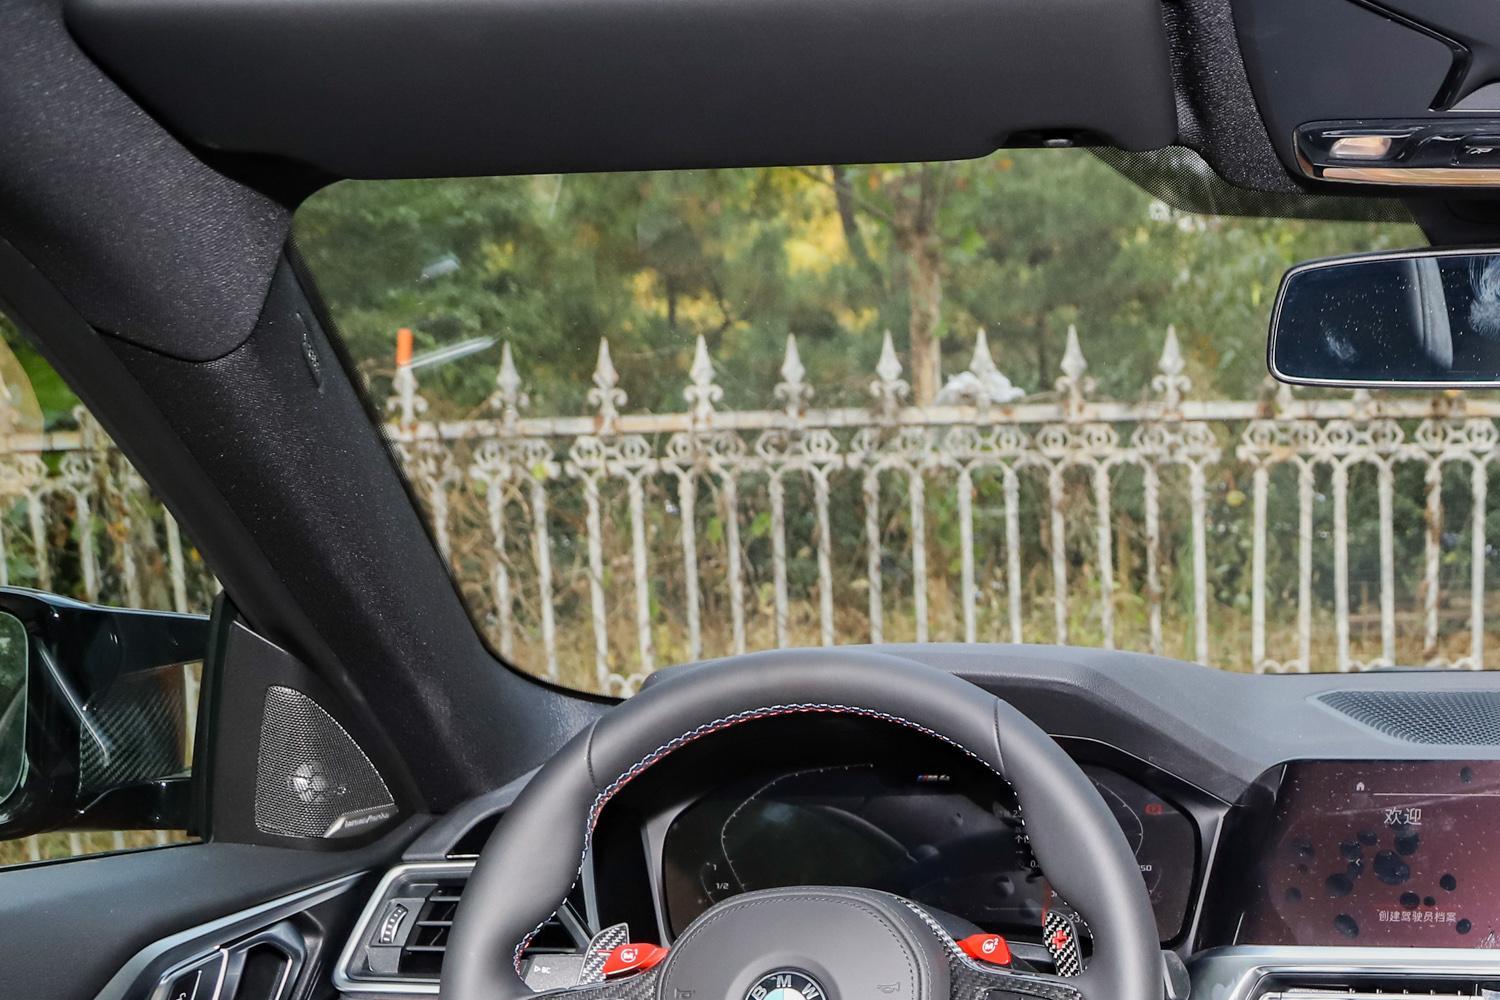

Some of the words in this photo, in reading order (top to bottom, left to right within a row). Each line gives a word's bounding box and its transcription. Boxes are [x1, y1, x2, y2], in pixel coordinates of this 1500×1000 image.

[1384, 807, 1422, 825] 欢迎
[716, 882, 729, 890] 1/2
[1378, 911, 1457, 923] 创建驾驶员档案
